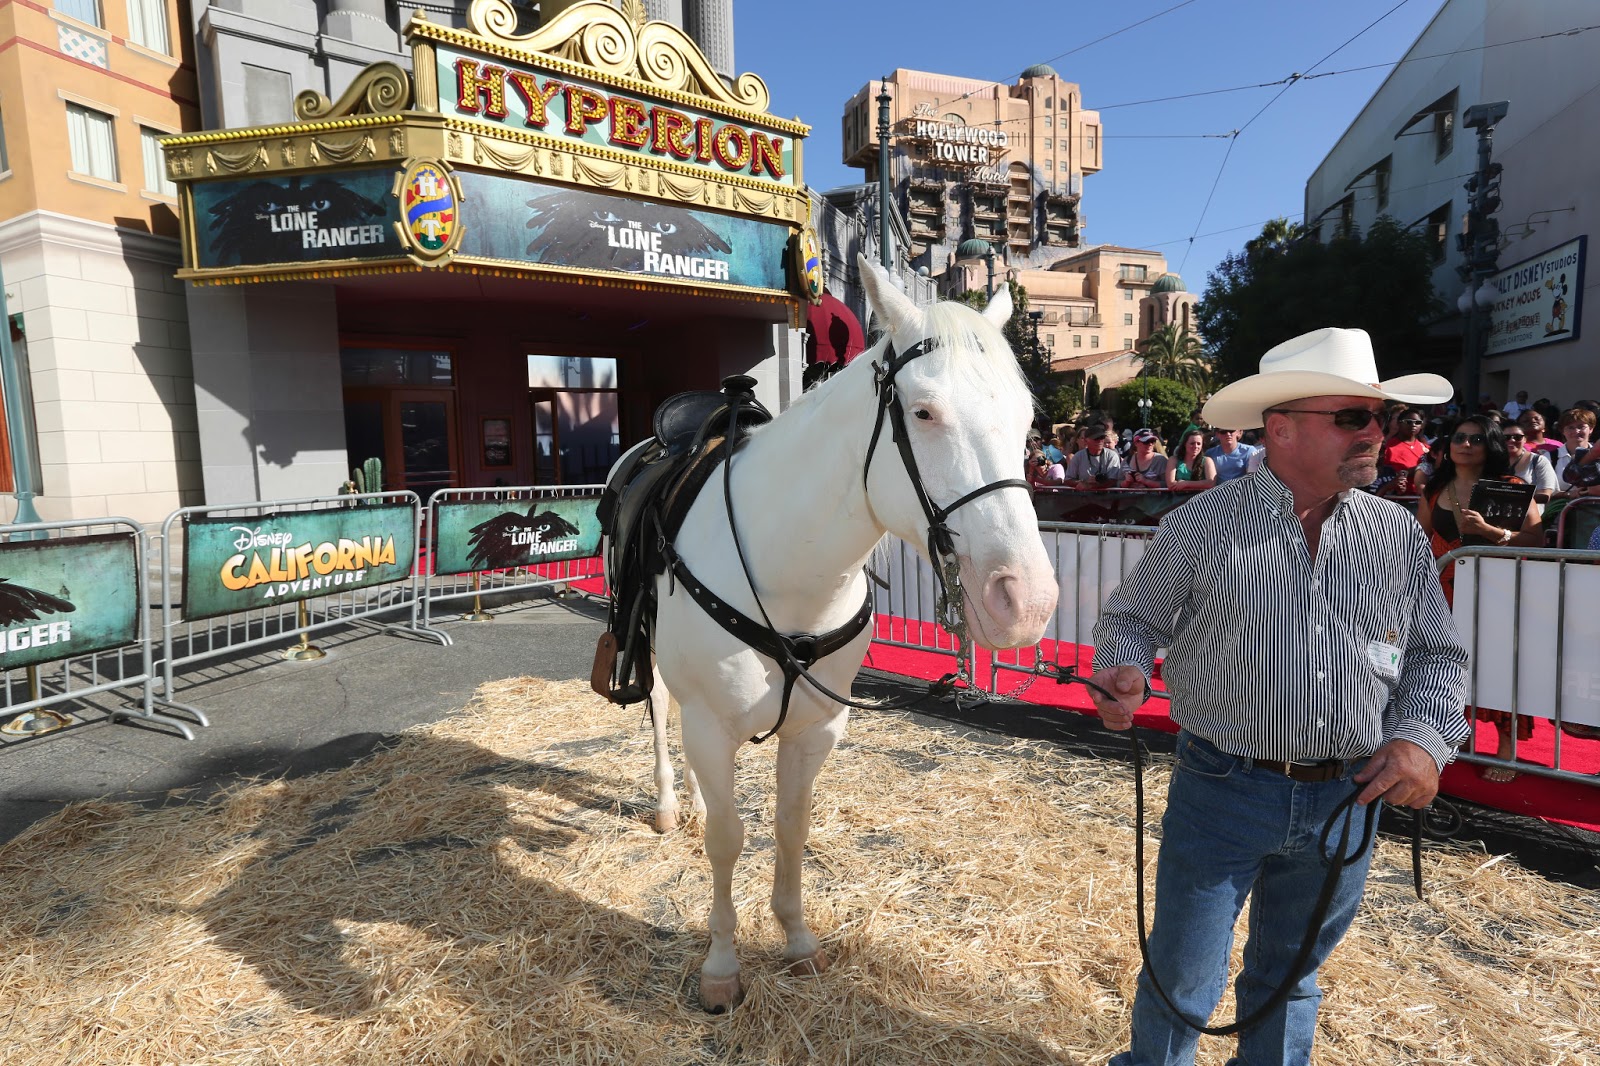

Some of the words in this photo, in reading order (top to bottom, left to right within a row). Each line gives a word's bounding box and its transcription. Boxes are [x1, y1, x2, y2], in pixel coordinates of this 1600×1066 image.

[455, 57, 785, 177] HYPERION
[916, 120, 1008, 147] HOLLYWOOD
[935, 142, 987, 163] TOWER
[971, 165, 1011, 181] Hotel
[418, 176, 437, 196] H
[270, 211, 318, 233] LONE
[421, 219, 441, 241] T
[627, 220, 642, 230] THE
[302, 225, 385, 249] RANGER
[607, 225, 662, 253] LONE
[643, 251, 729, 281] RANGER
[1513, 260, 1547, 290] DISNEY
[1546, 252, 1577, 274] STUDIOS
[1516, 287, 1541, 306] MOUSE
[511, 531, 542, 546] LONE
[529, 539, 578, 556] RANGER
[220, 534, 396, 591] CALIFORNIA
[264, 570, 364, 598] ADVENTURE
